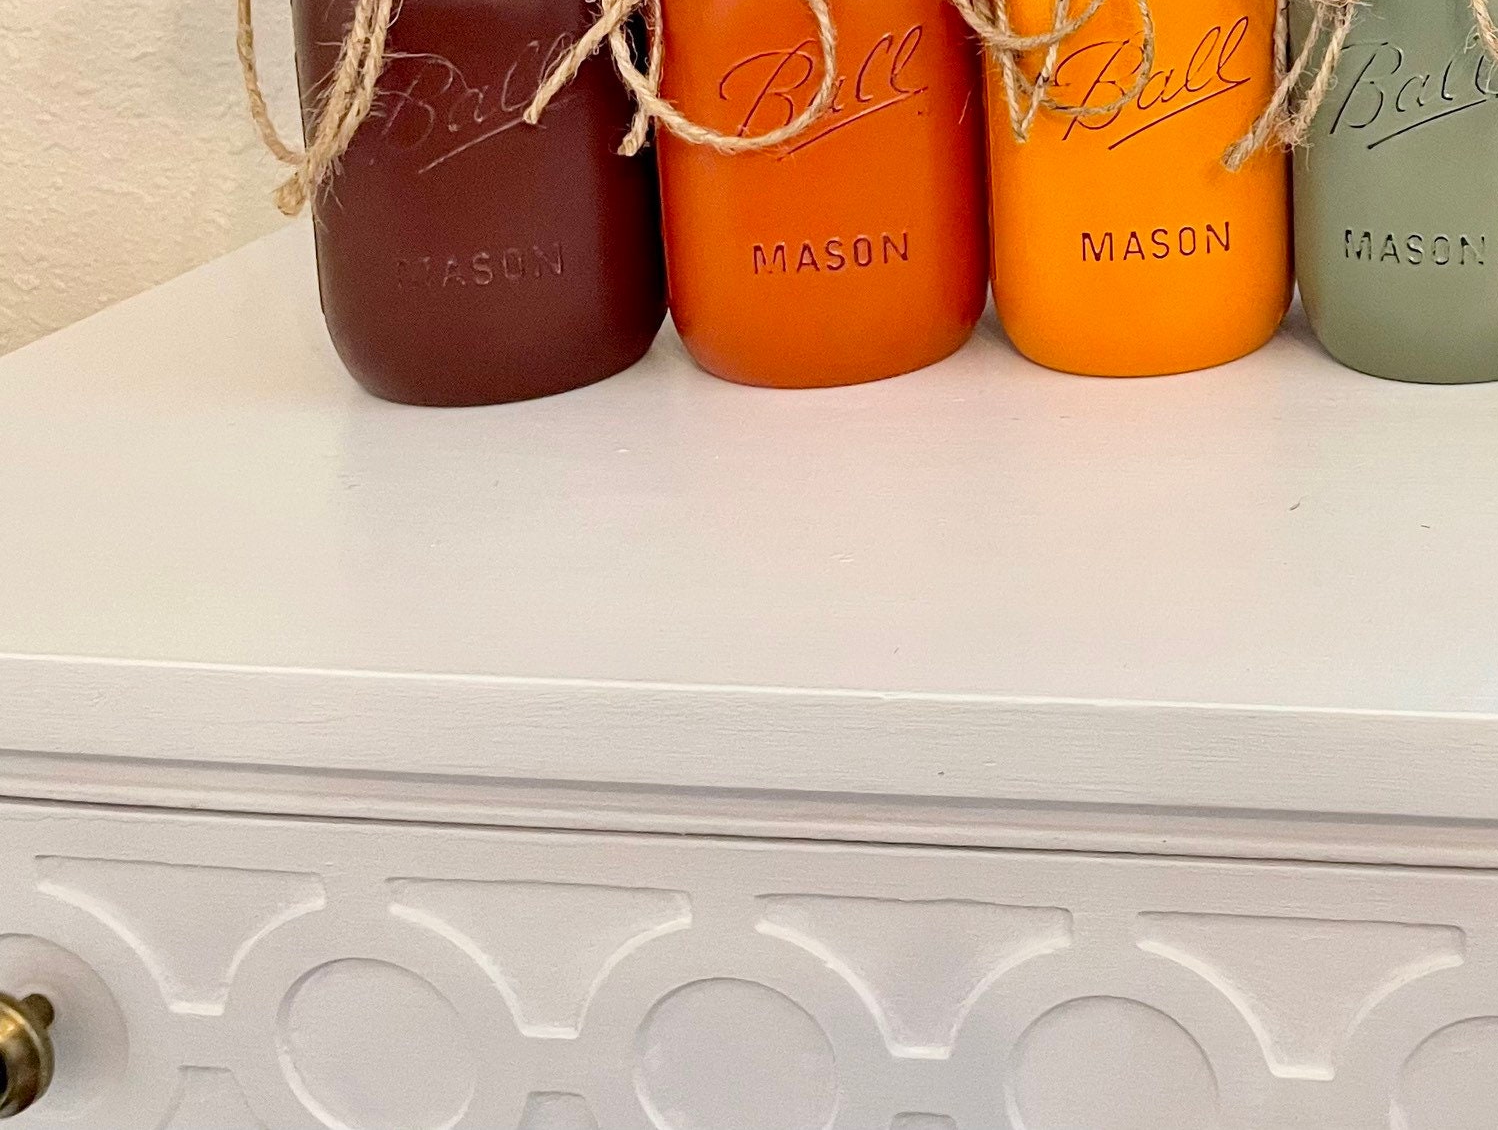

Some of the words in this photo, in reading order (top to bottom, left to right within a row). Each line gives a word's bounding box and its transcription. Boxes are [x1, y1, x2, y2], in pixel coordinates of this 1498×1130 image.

[1053, 16, 1252, 151] Ball
[752, 232, 909, 275] MASON
[1081, 222, 1231, 263] MASON
[1343, 228, 1487, 266] MASON
